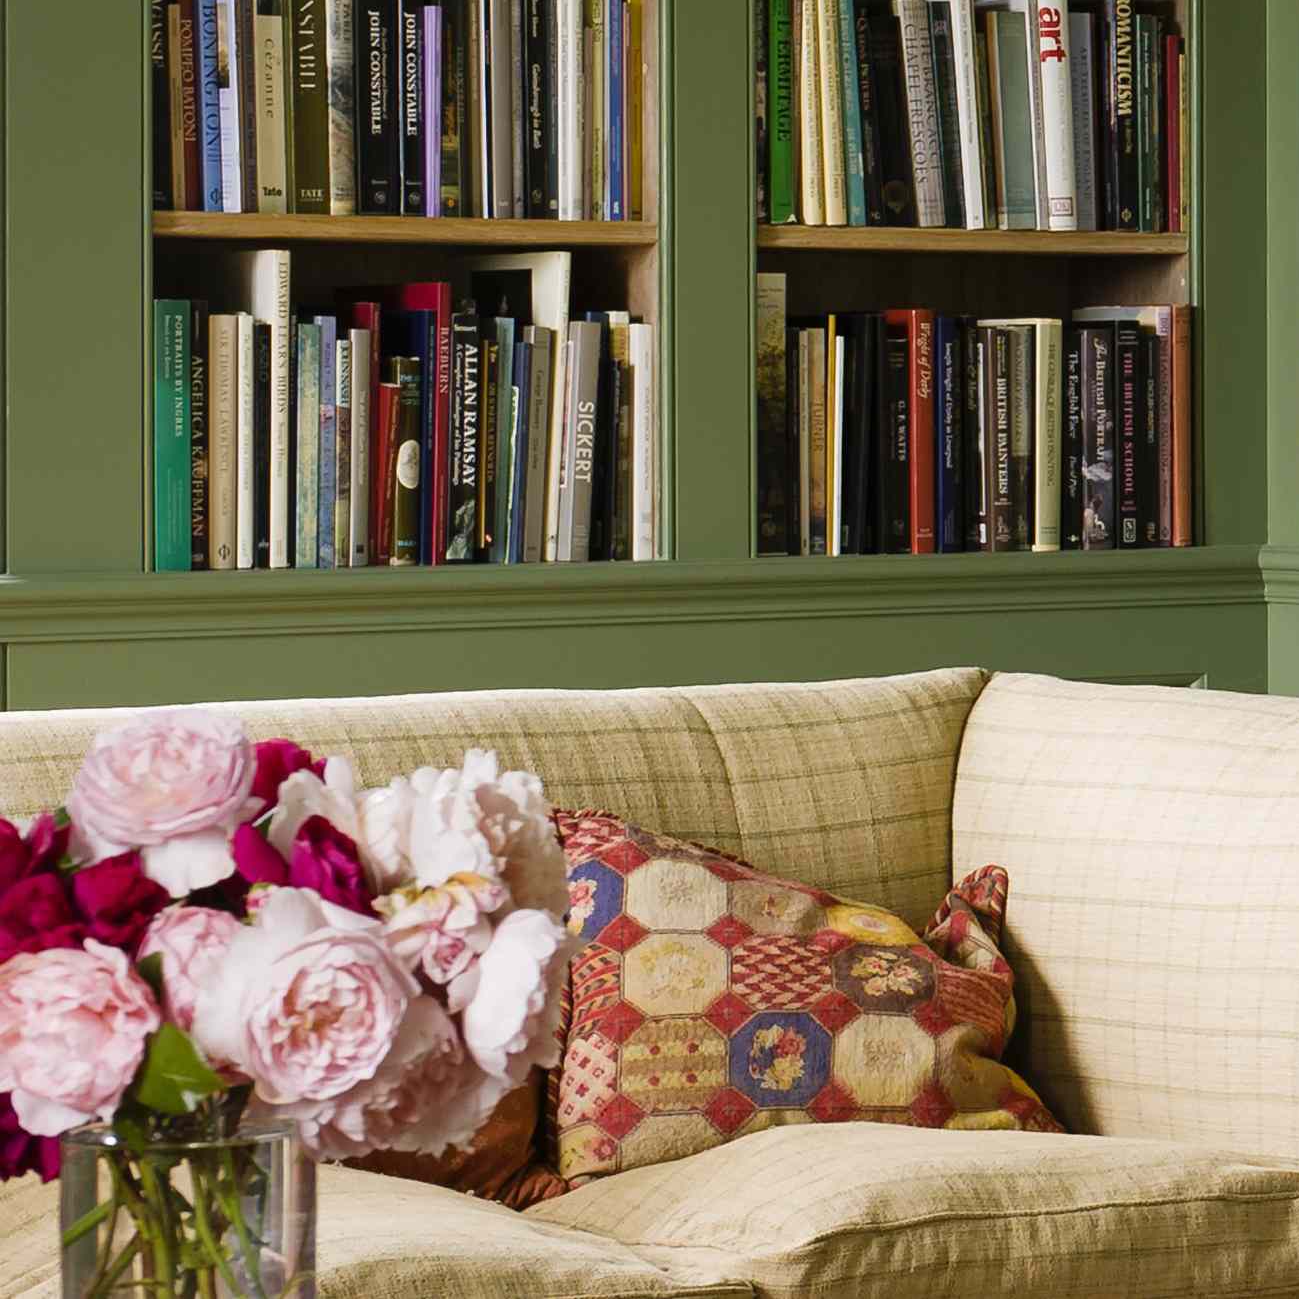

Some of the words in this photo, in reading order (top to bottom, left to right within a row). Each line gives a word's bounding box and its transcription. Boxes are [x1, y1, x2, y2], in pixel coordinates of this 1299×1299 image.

[332, 0, 343, 41] Drawings
[367, 10, 380, 47] JOHN
[405, 12, 417, 47] JOHN
[919, 25, 931, 62] THE
[1039, 7, 1067, 62] art
[180, 19, 193, 82] POMPEO
[202, 5, 220, 148] BONINGTON
[906, 23, 920, 91] CHAPEL
[263, 38, 280, 120] Cézanne
[368, 50, 381, 135] CONSTABLE
[405, 50, 418, 136] CONSTABLE
[530, 63, 542, 118] Gainsborough
[183, 86, 197, 142] BATONI
[532, 129, 542, 149] Bath
[533, 119, 541, 127] in
[923, 65, 939, 171] BRANCACCI
[911, 98, 927, 184] FRESCOES
[277, 261, 289, 319] EDWARD
[174, 315, 183, 377] PORTRAITS
[219, 330, 229, 350] SIR
[439, 327, 449, 394] RAEBURN
[917, 321, 931, 354] Wright
[917, 356, 931, 366] of
[1068, 350, 1078, 371] The
[1123, 351, 1133, 376] THE
[174, 380, 183, 393] BY
[219, 353, 229, 403] THOMAS
[277, 375, 289, 415] BIRDS
[454, 351, 462, 388] Complete
[464, 343, 478, 406] ALLAN
[917, 369, 931, 399] Derby
[1067, 374, 1078, 414] English
[1096, 361, 1106, 406] BRITISH
[174, 397, 183, 438] INGRES
[191, 355, 204, 440] ANGELICA
[996, 378, 1007, 430] BRITISH
[1123, 382, 1134, 436] BRITISH
[219, 409, 229, 474] LAWRENCE
[462, 410, 477, 488] RAMSAY
[575, 400, 594, 483] SICKERT
[813, 401, 824, 452] TURNER
[898, 425, 906, 462] WATTS
[1096, 409, 1108, 461] PORTRAIT
[997, 432, 1008, 494] PAINTERS
[1123, 441, 1134, 494] SCHOOL
[191, 445, 204, 537] KAUFFMAN
